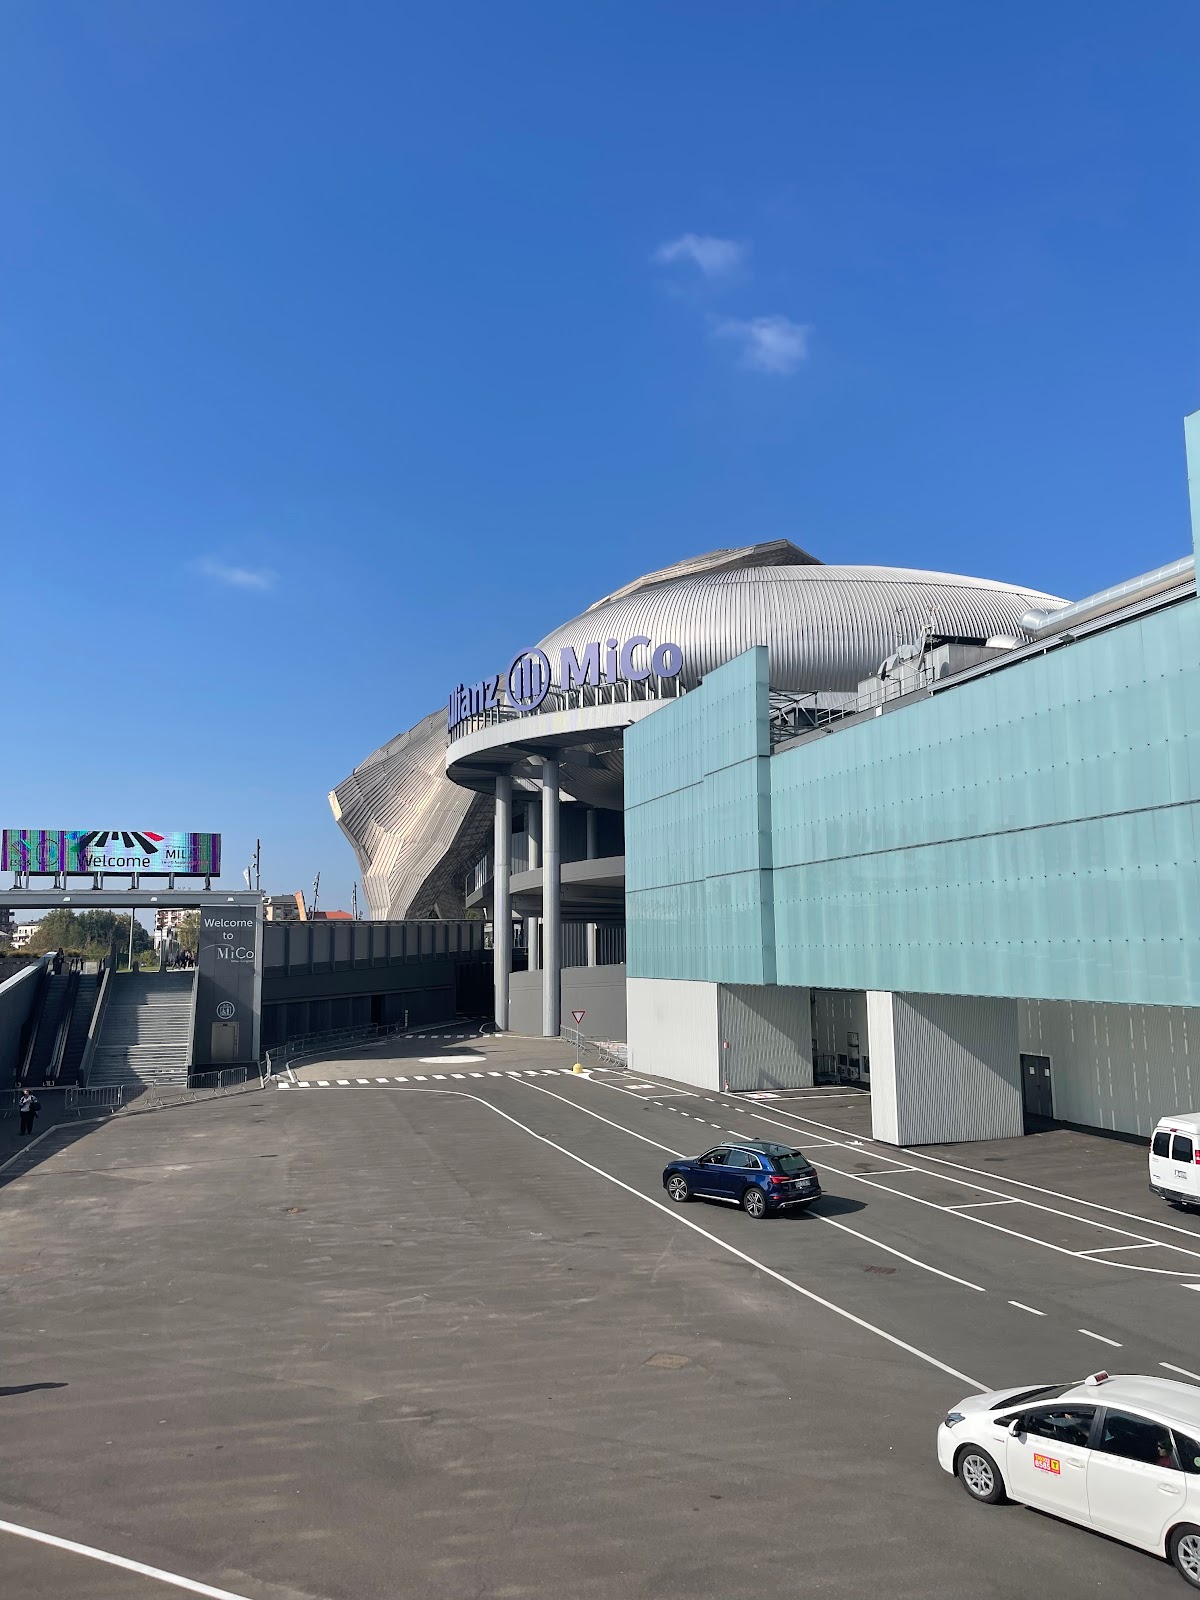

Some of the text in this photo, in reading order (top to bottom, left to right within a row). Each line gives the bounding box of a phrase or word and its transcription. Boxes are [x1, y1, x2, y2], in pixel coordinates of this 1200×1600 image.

[560, 635, 684, 691] MiCo
[77, 854, 151, 868] Welcome
[204, 918, 253, 928] Welcome
[222, 931, 234, 940] to
[217, 946, 255, 960] MiCo
